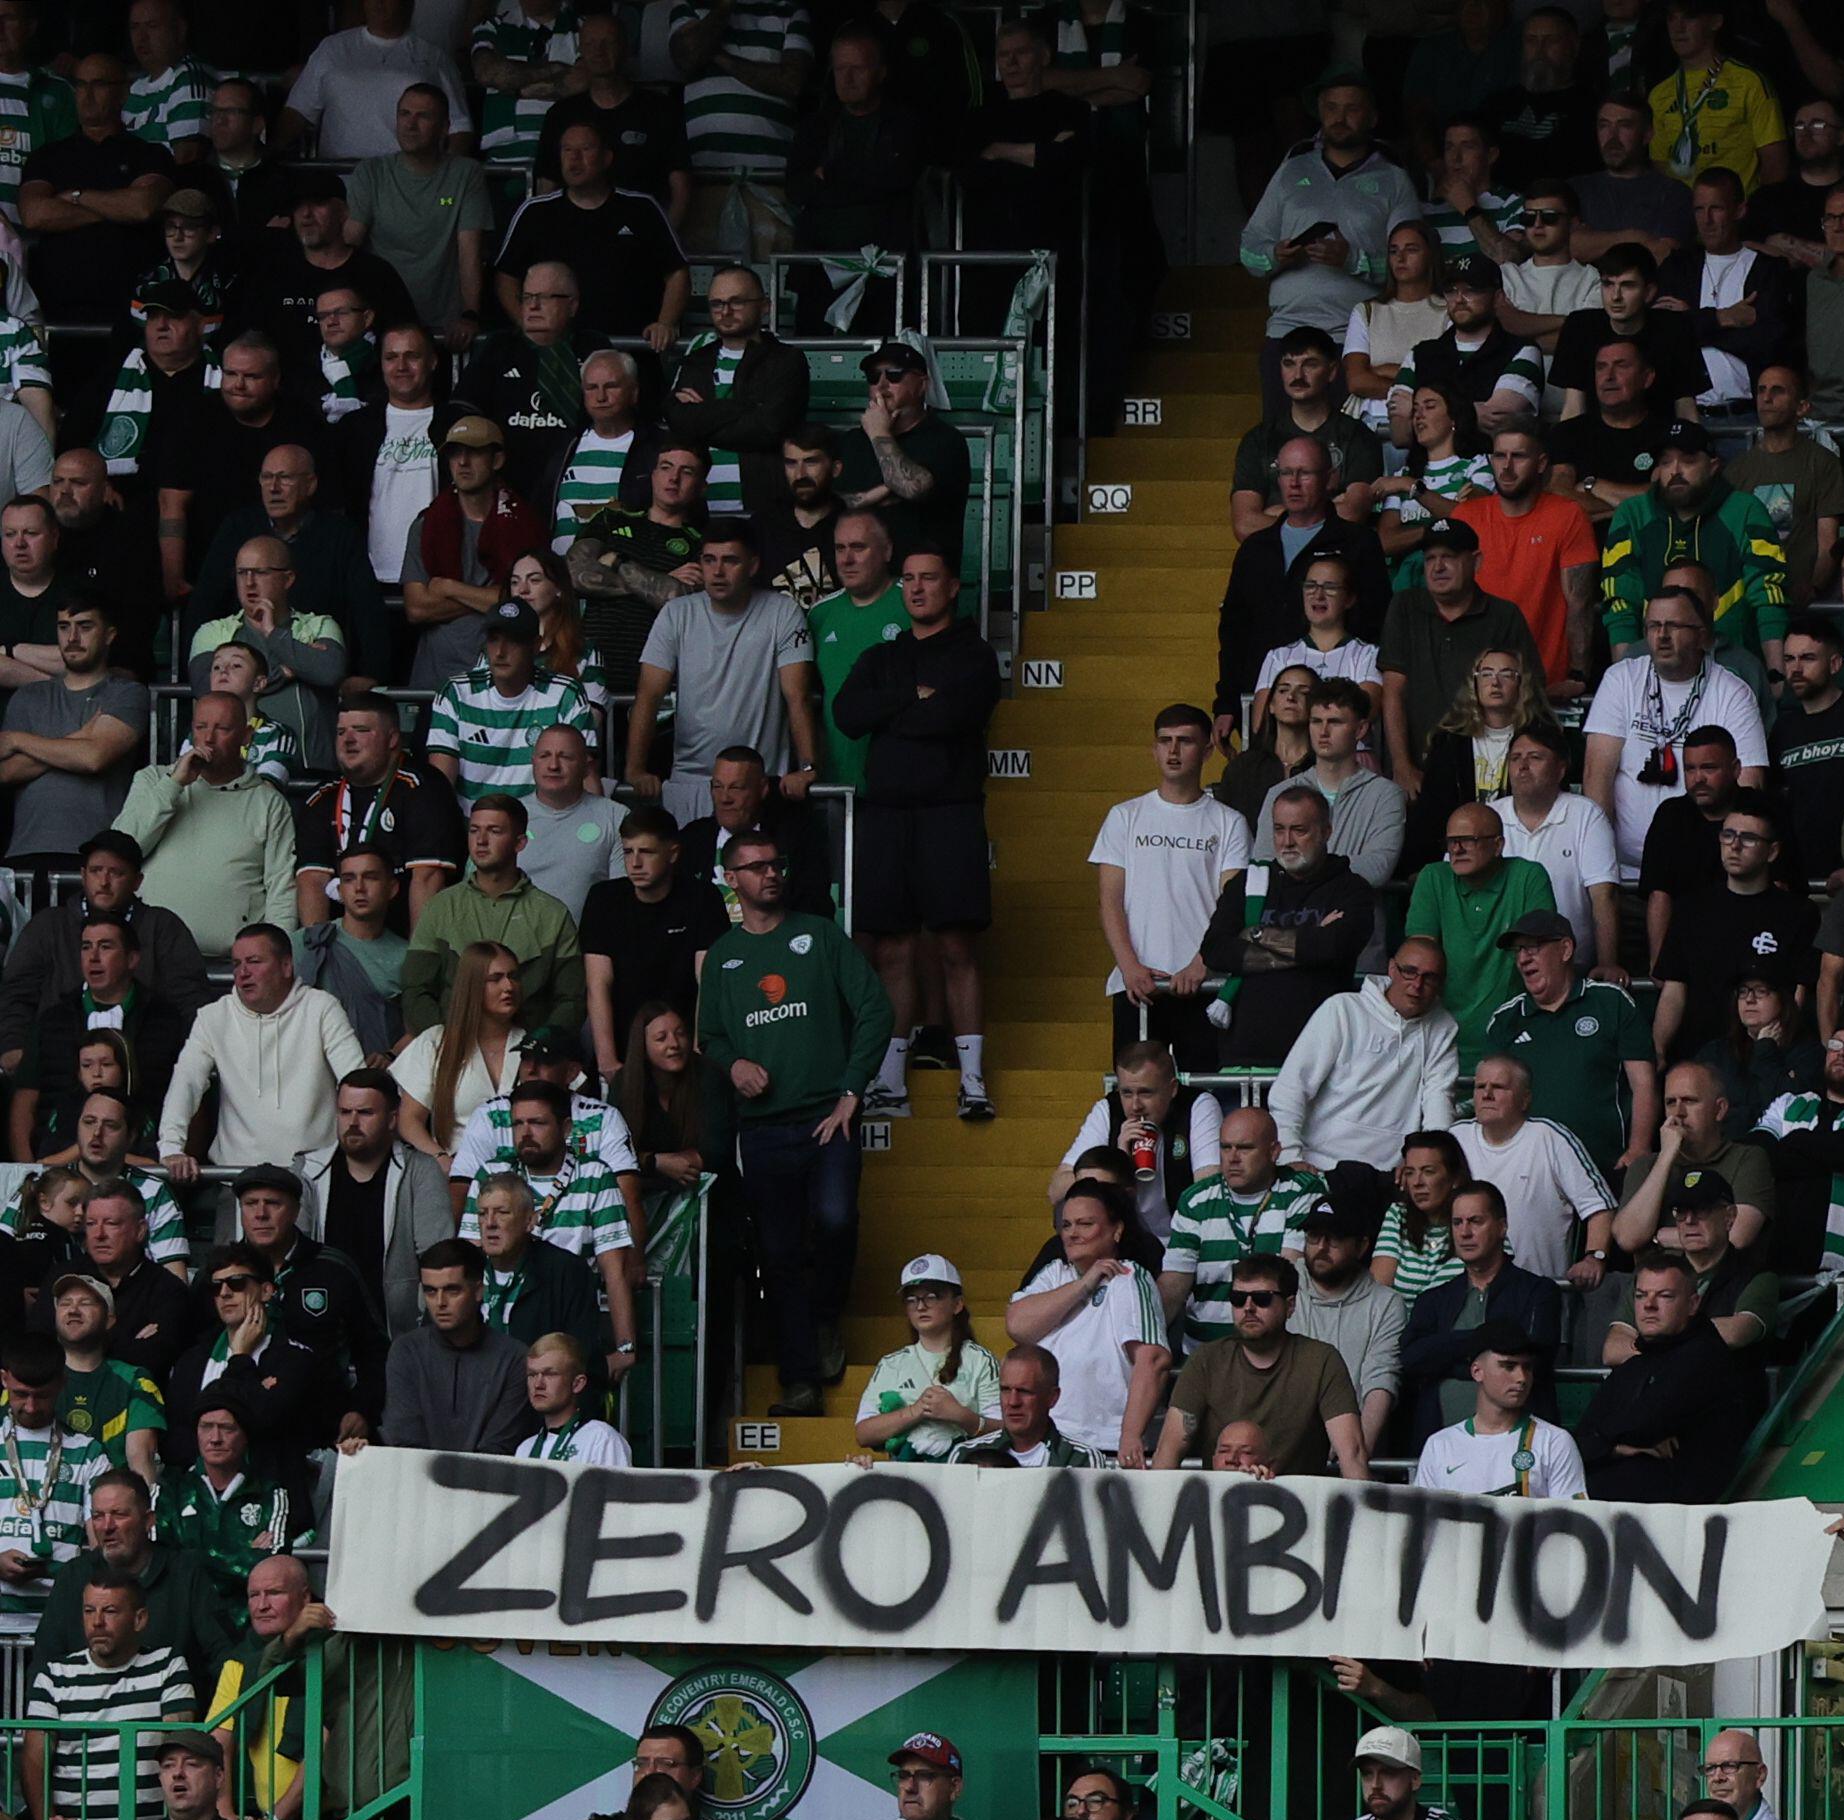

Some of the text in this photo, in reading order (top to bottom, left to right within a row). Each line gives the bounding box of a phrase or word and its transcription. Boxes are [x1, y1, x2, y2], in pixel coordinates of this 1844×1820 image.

[1153, 315, 1189, 338] SS
[508, 411, 567, 430] dafabe
[1124, 401, 1160, 424] RR
[1091, 488, 1130, 511] QQ
[1061, 575, 1095, 597] PP
[1024, 663, 1063, 685] NN
[990, 752, 1030, 774] MM
[1136, 835, 1215, 854] MONCLER
[741, 1426, 778, 1449] EE
[0, 1519, 64, 1539] afaet
[413, 1453, 1728, 1649] ZERO AMBITION
[667, 1674, 726, 1716] COVENTRY
[730, 1674, 787, 1708] EMERALD
